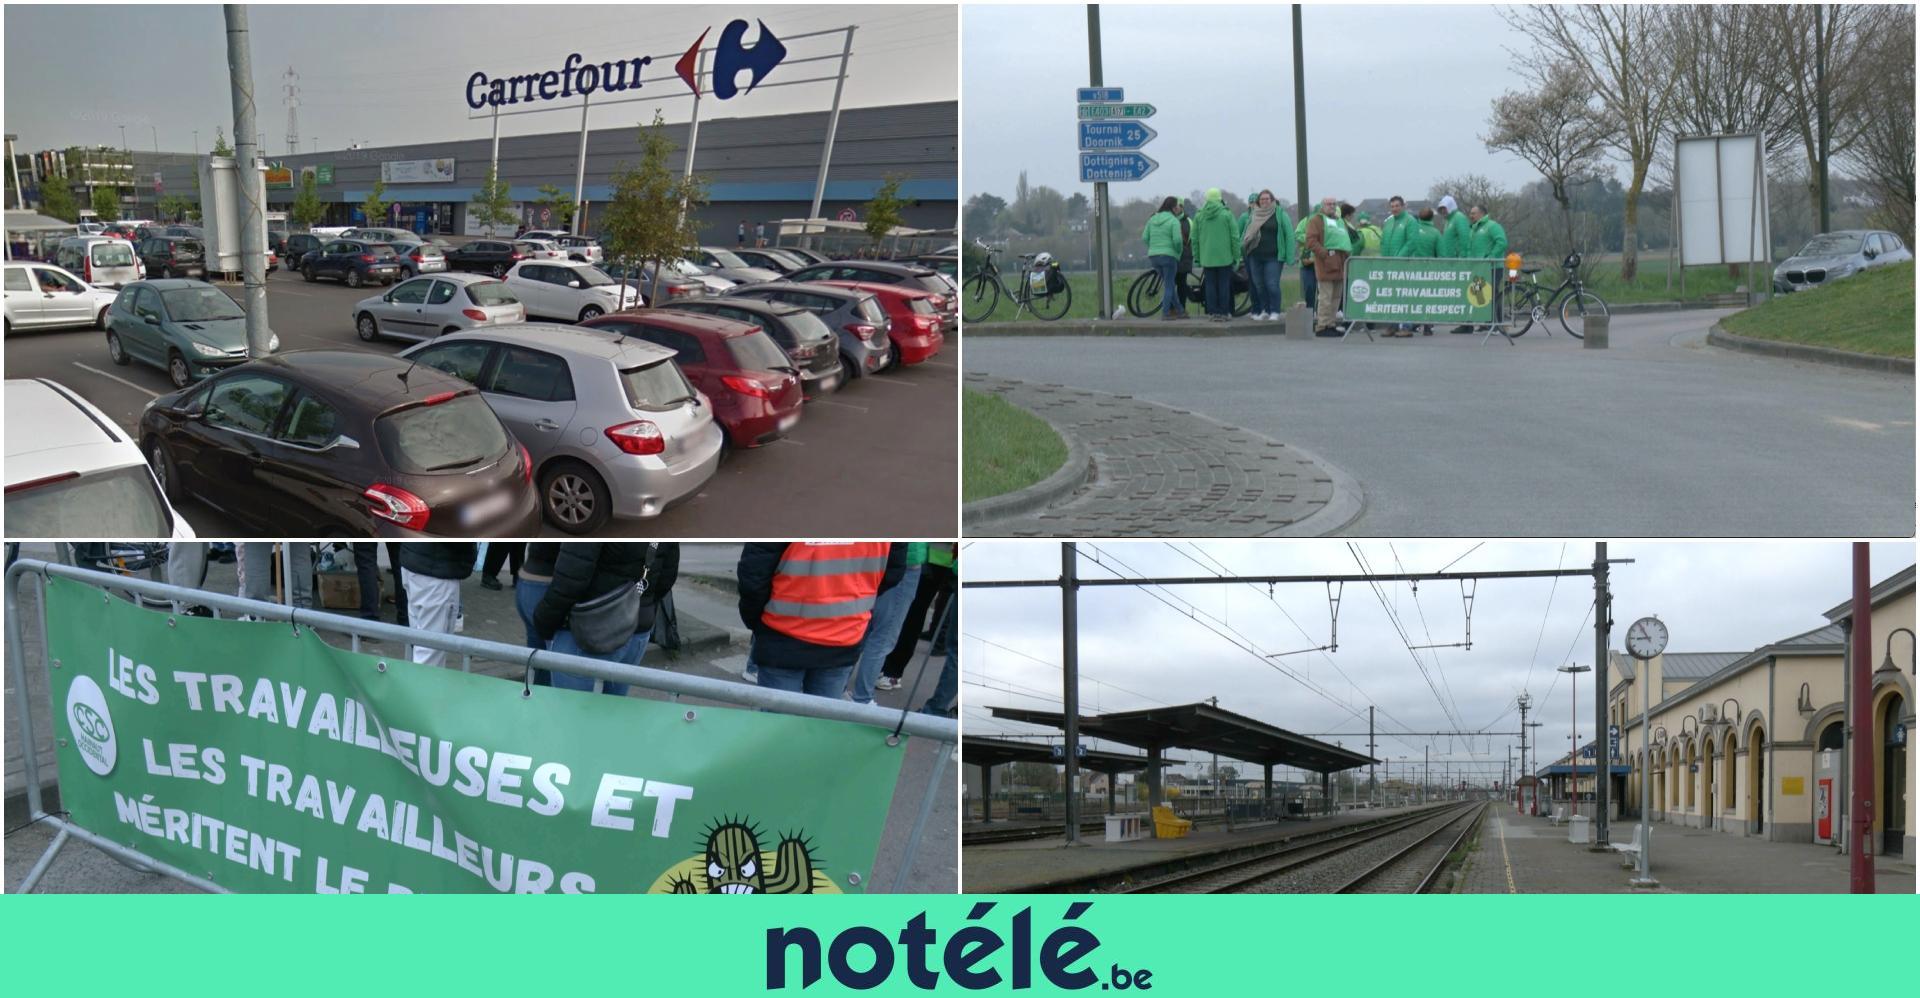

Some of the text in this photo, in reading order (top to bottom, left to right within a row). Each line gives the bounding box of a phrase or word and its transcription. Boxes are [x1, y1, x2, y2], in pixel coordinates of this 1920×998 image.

[466, 52, 652, 109] Carrefour
[1085, 124, 1122, 135] Tournai
[1127, 129, 1141, 140] 25
[1085, 137, 1123, 147] Doornik
[1083, 156, 1134, 168] Dottignies
[1137, 161, 1144, 171] 5
[1086, 168, 1133, 180] Dottenijs
[1368, 270, 1472, 281] LES TRAVAILLEUSES ET
[1376, 287, 1393, 297] LES
[1395, 287, 1461, 298] TRAVAILLEURS
[1365, 301, 1409, 314] MÉRITENT
[1411, 304, 1423, 314] LE
[1425, 304, 1466, 315] RESPECT
[74, 703, 109, 741] CSC
[109, 647, 694, 838] LES TRAVAILLEUSES ET
[142, 738, 596, 894] LES TRAVAILLEURS
[114, 790, 370, 894] MÉRITENT LE
